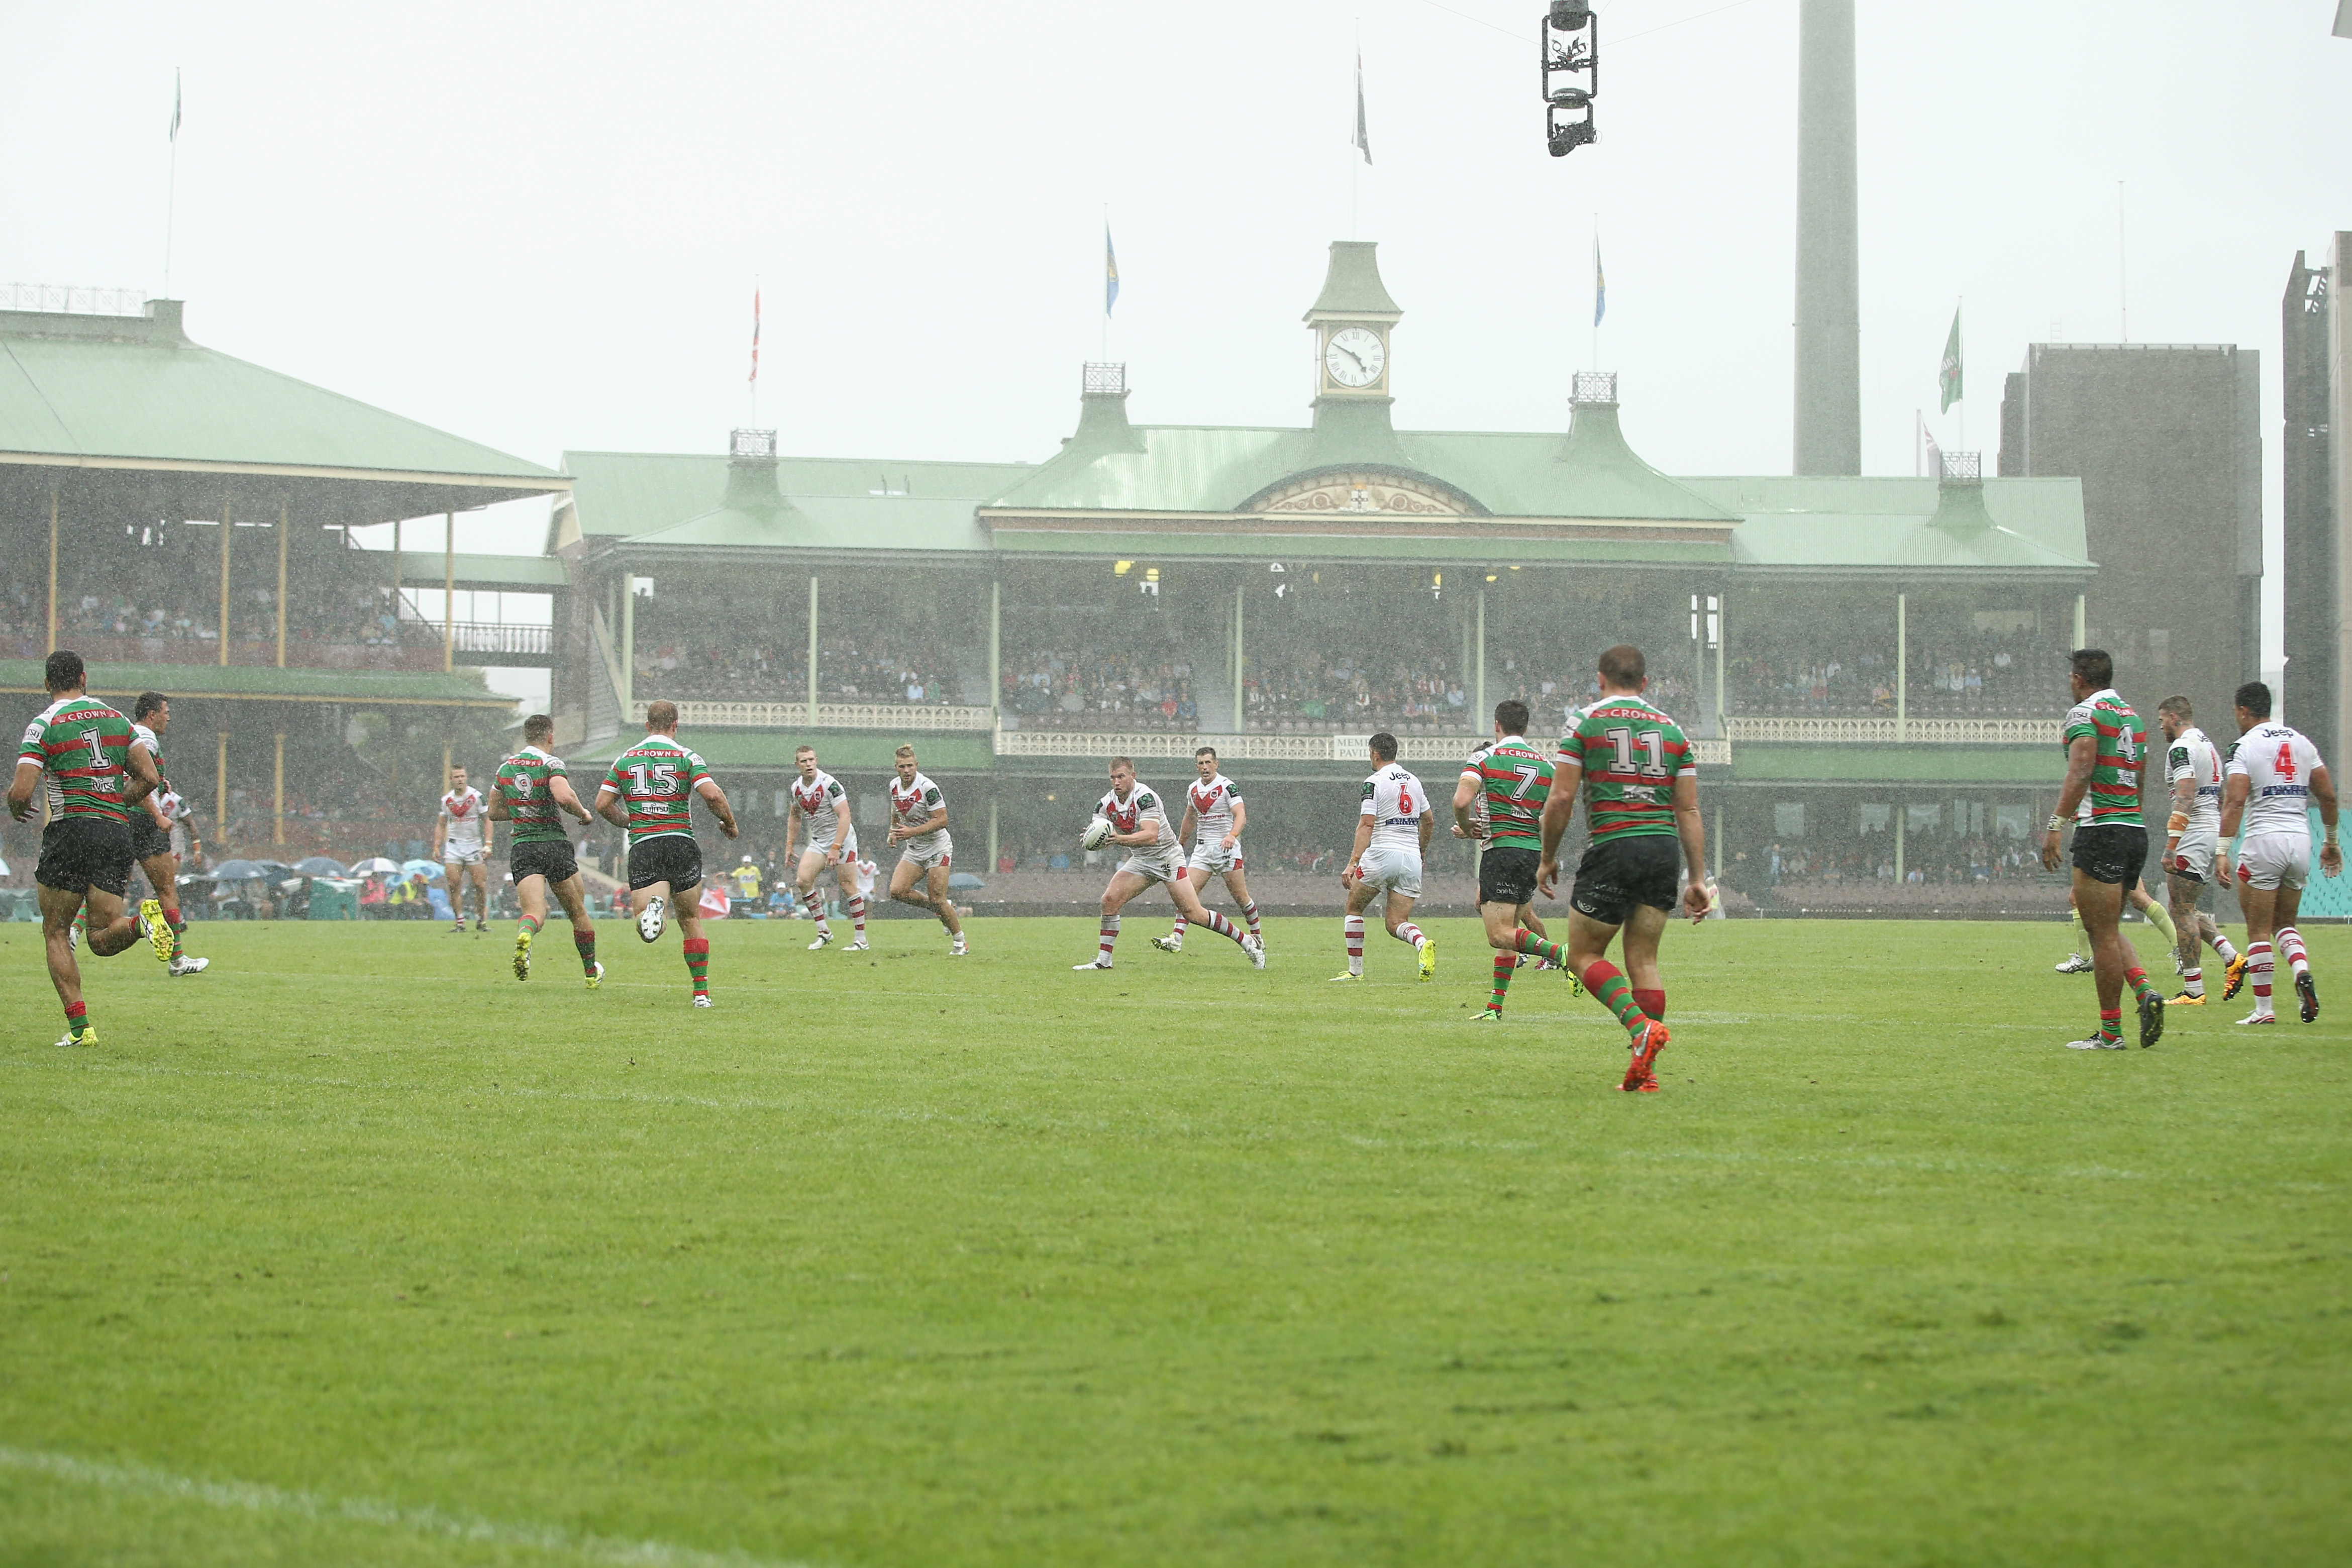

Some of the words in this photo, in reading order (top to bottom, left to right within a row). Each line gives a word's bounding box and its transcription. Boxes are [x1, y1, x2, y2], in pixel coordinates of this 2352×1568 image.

[68, 710, 107, 721] CROWN
[80, 727, 112, 770] 1
[2116, 723, 2137, 764] 4
[2262, 729, 2294, 738] Jeep
[1508, 750, 1540, 760] CROWN
[1605, 726, 1668, 779] 11
[2272, 741, 2299, 783] 4
[513, 772, 533, 801] 9
[629, 763, 679, 797] 15
[1389, 772, 1410, 781] Jeep
[1510, 763, 1539, 801] 7
[1398, 782, 1413, 815] 6
[1511, 809, 1532, 817] FUJITS
